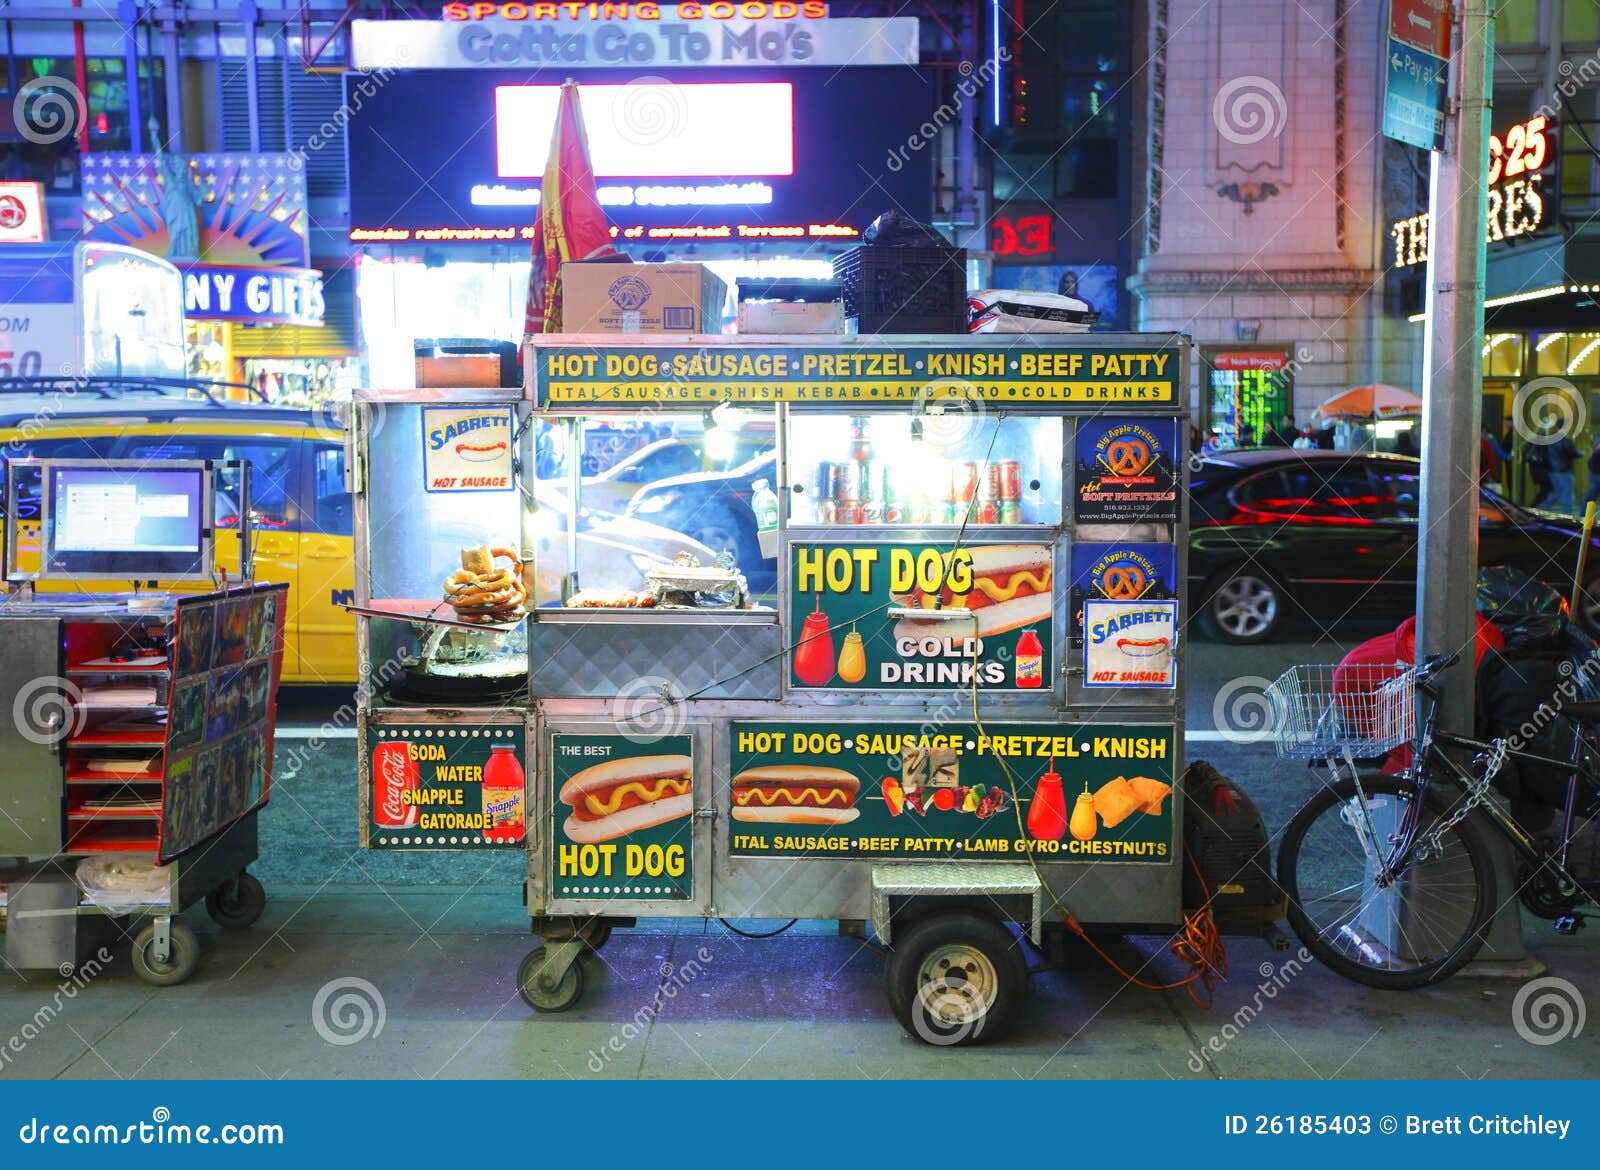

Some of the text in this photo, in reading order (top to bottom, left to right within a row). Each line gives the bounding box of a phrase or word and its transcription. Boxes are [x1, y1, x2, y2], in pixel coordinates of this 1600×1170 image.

[444, 0, 828, 21] SPORTING GOODS
[458, 23, 814, 63] Gotta Go To Mo's
[1404, 54, 1433, 84] Pay at
[1505, 116, 1546, 177] 25
[185, 273, 325, 322] NY GIFTS
[548, 354, 1169, 377] HOT DOG SAUSAGE PRETZEL KNISH BEEF PATTY
[556, 386, 1161, 398] ITAL SAUSAGE SHISH KEBAB LAMB GYRO COLD DRINKS
[429, 414, 509, 450] SABRETT
[1096, 425, 1160, 450] Big Apple Pretzels
[433, 477, 507, 488] HOT SAUSAGE
[1083, 492, 1176, 501] SOFT PRETZELS
[798, 548, 974, 594] HOT DOG
[1092, 551, 1155, 576] Big Apple Pretzels
[1091, 610, 1172, 644] SABRETT
[880, 636, 1005, 683] COLD DRINKS
[1092, 671, 1167, 682] HOT SAUSAGE
[410, 745, 446, 761] SODA
[560, 746, 612, 756] THE BEST
[738, 732, 1167, 758] HOT DOG SAUSAGE PRETZEL KNISH
[436, 766, 482, 782] WATER
[402, 789, 464, 805] SNAPPLE
[487, 795, 520, 815] Snapple
[420, 813, 492, 829] GATORADE
[734, 835, 1167, 855] ITAL SAUSAGE BEEF PATTY LAMB GYRO CHESTNUTS
[559, 844, 685, 877] HOT DOG
